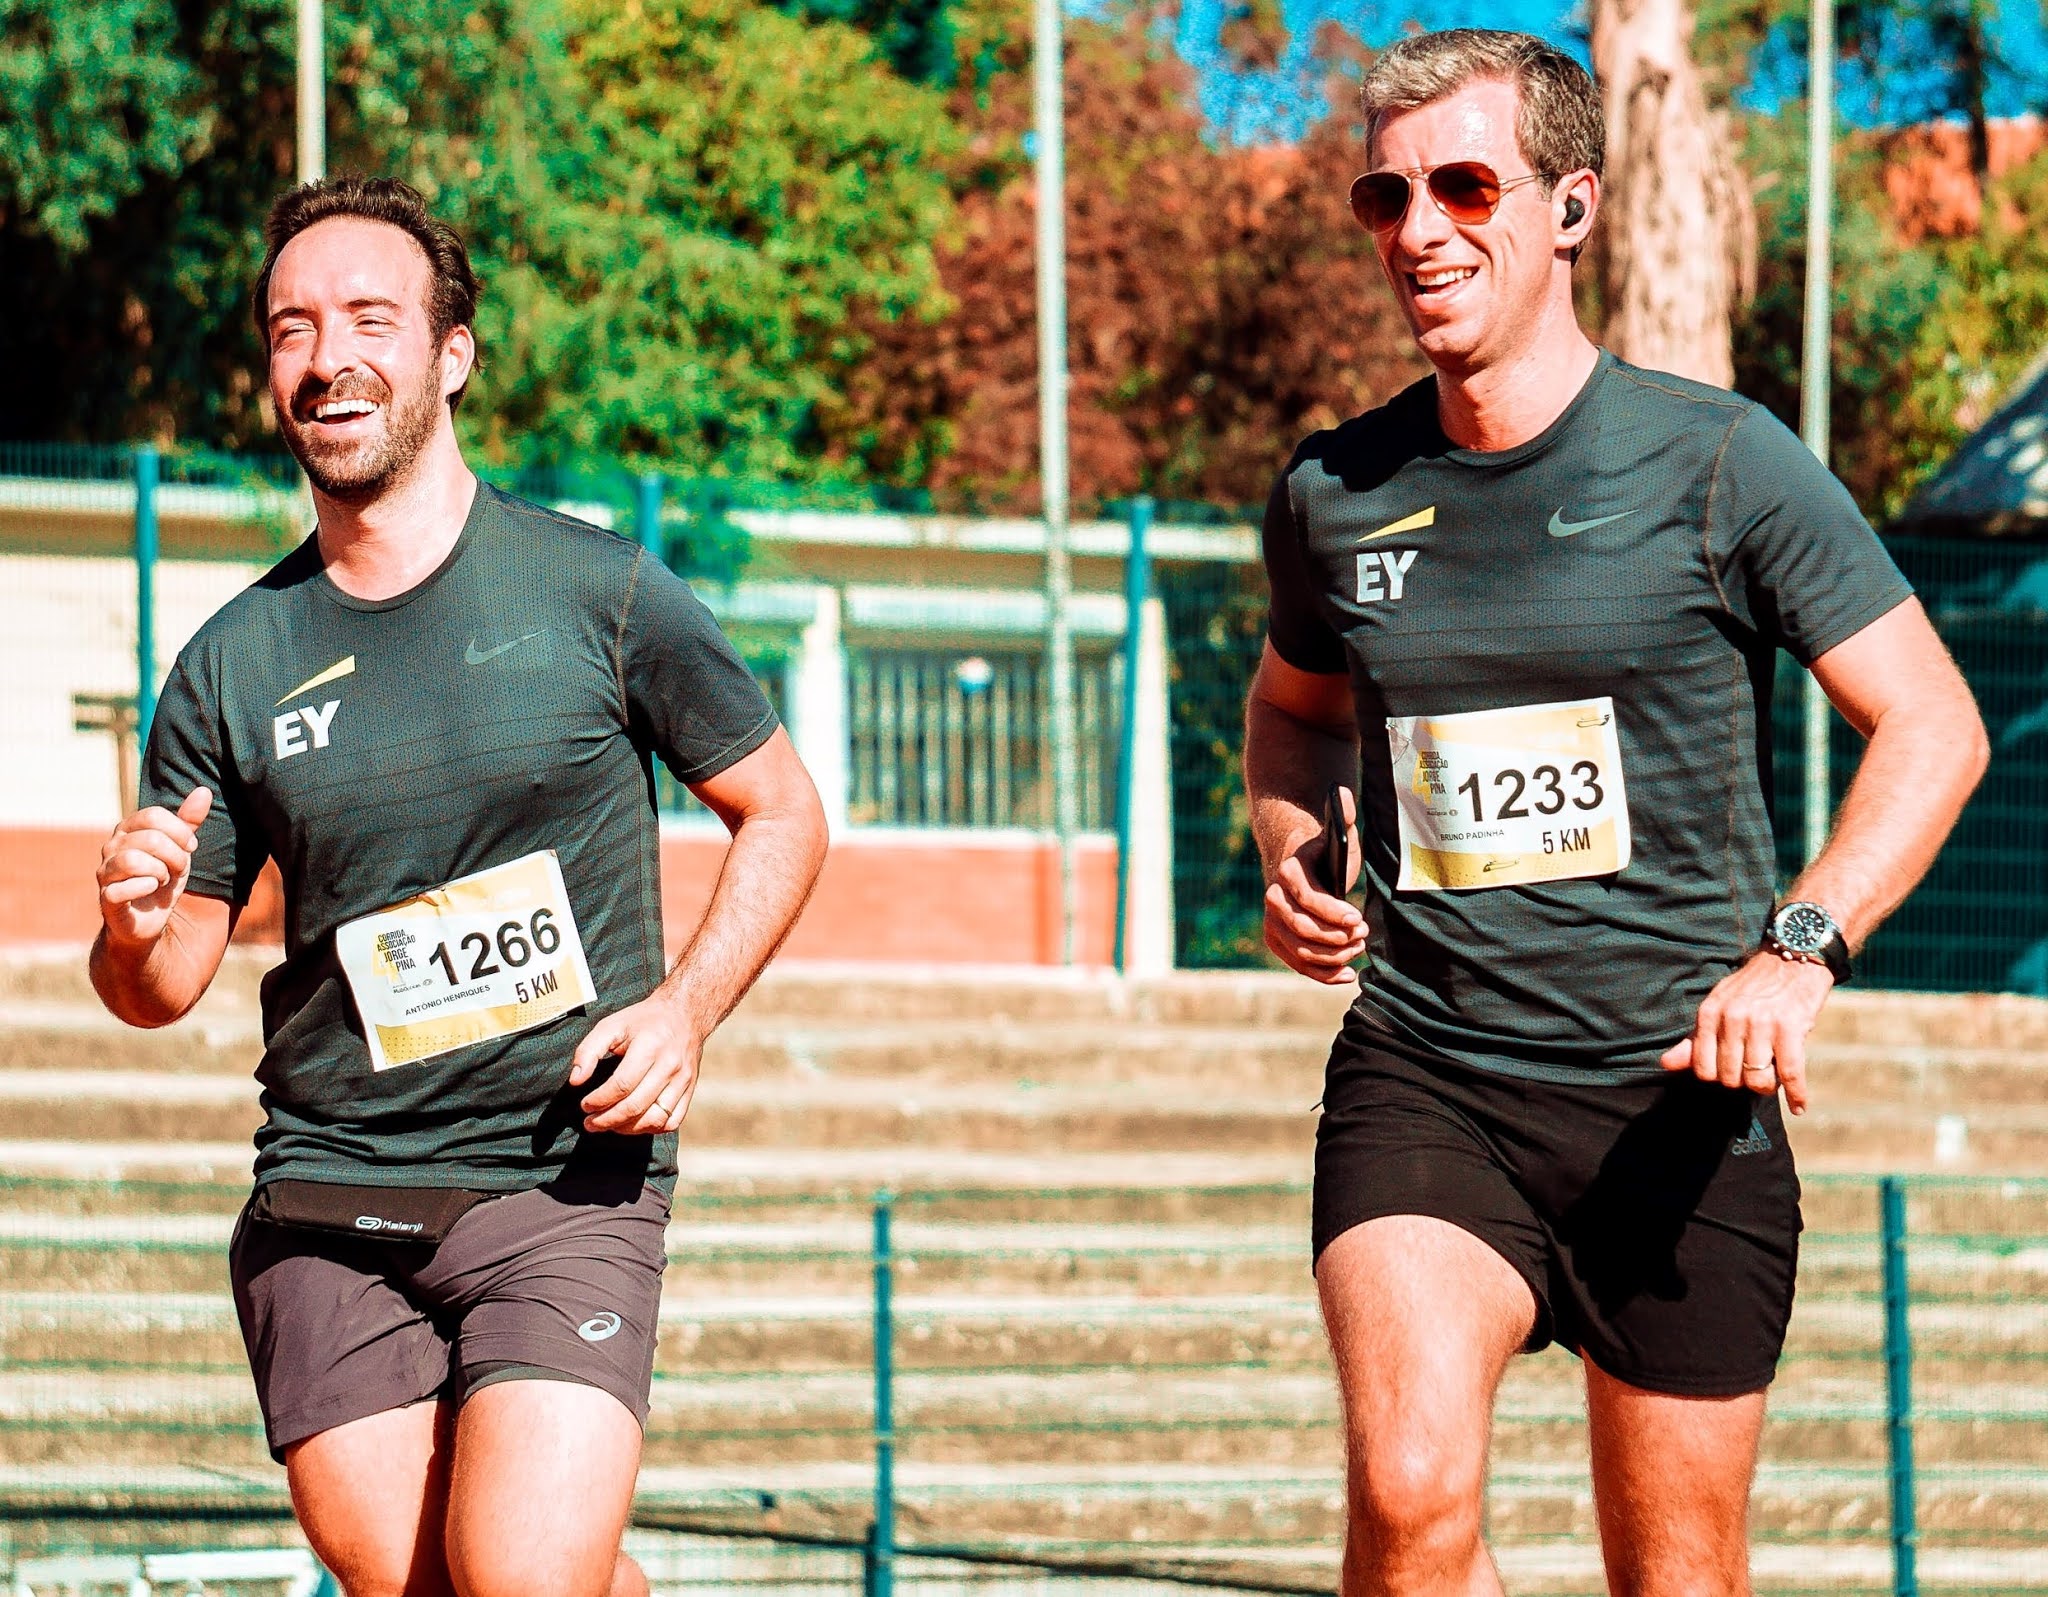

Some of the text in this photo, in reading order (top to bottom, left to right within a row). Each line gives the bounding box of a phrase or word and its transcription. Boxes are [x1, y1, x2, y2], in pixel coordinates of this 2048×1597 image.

[1357, 550, 1419, 603] EY
[274, 699, 341, 760] EY
[1458, 760, 1604, 822] 1233
[1440, 829, 1504, 841] BRUNO PADINHA
[1542, 827, 1591, 854] 5 KM
[377, 934, 416, 952] ASSOCIAÇÃO
[378, 929, 406, 943] CORRIDA
[429, 907, 560, 986] 1266
[383, 947, 408, 963] JORGE
[395, 958, 416, 972] PINA
[443, 984, 491, 1003] HENRIQUES
[515, 970, 558, 1004] 5 KM
